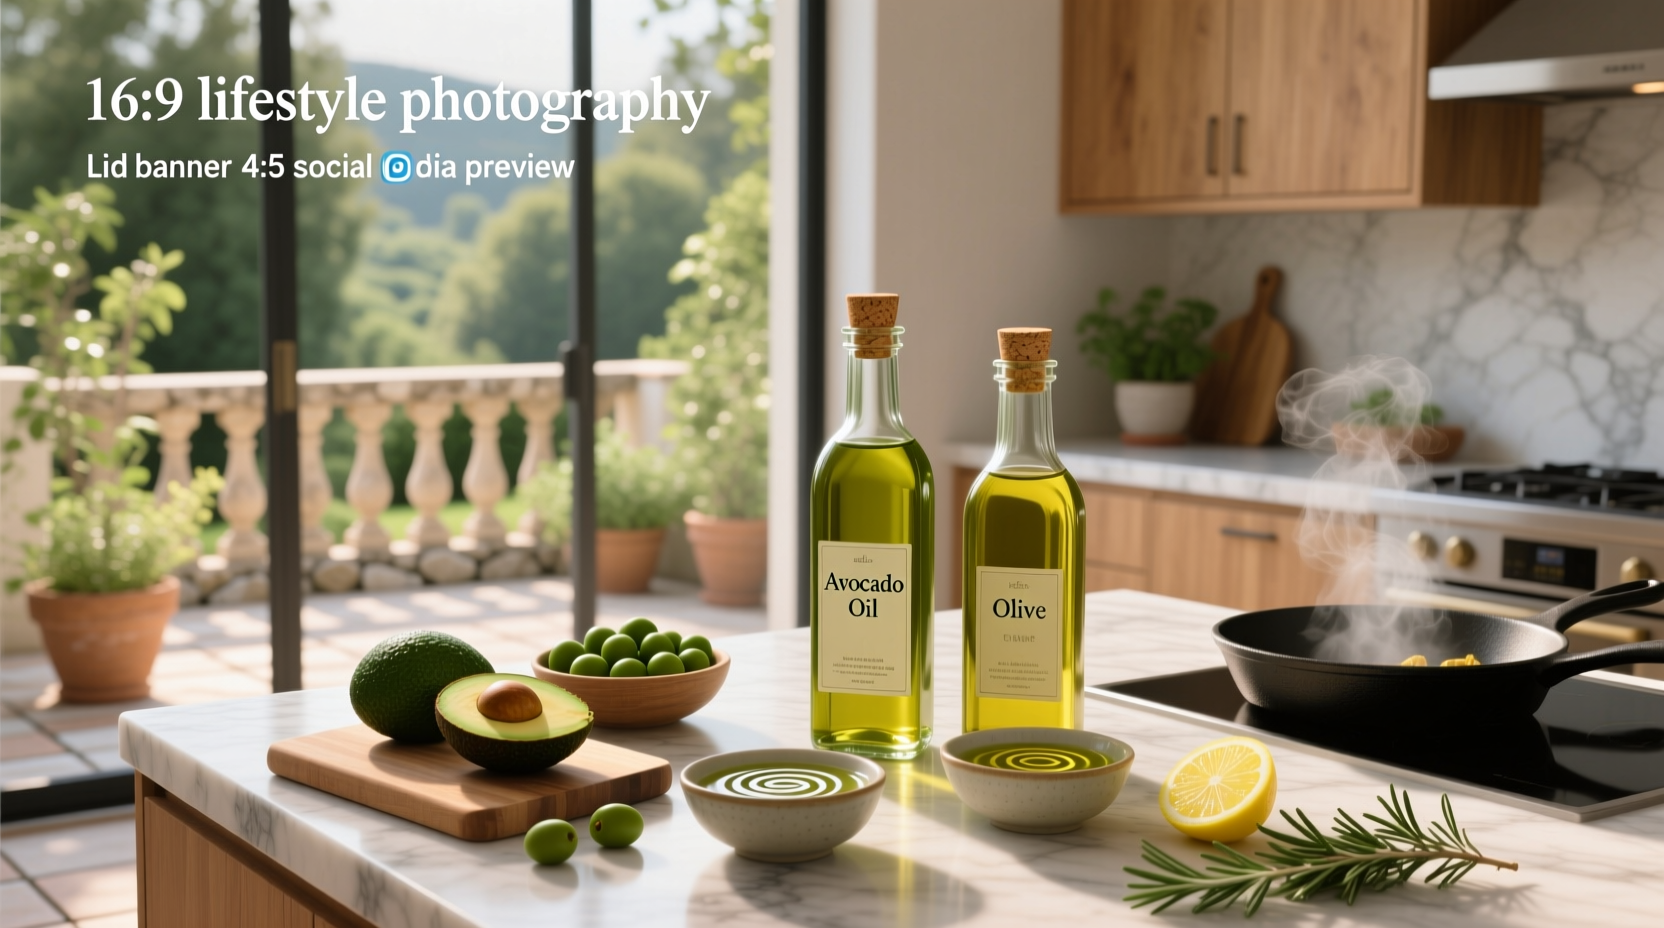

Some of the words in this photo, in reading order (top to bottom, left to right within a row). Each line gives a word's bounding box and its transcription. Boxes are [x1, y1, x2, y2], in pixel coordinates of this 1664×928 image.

[823, 571, 905, 593] Avocado
[848, 597, 878, 618] Oil
[992, 597, 1046, 620] Olive
